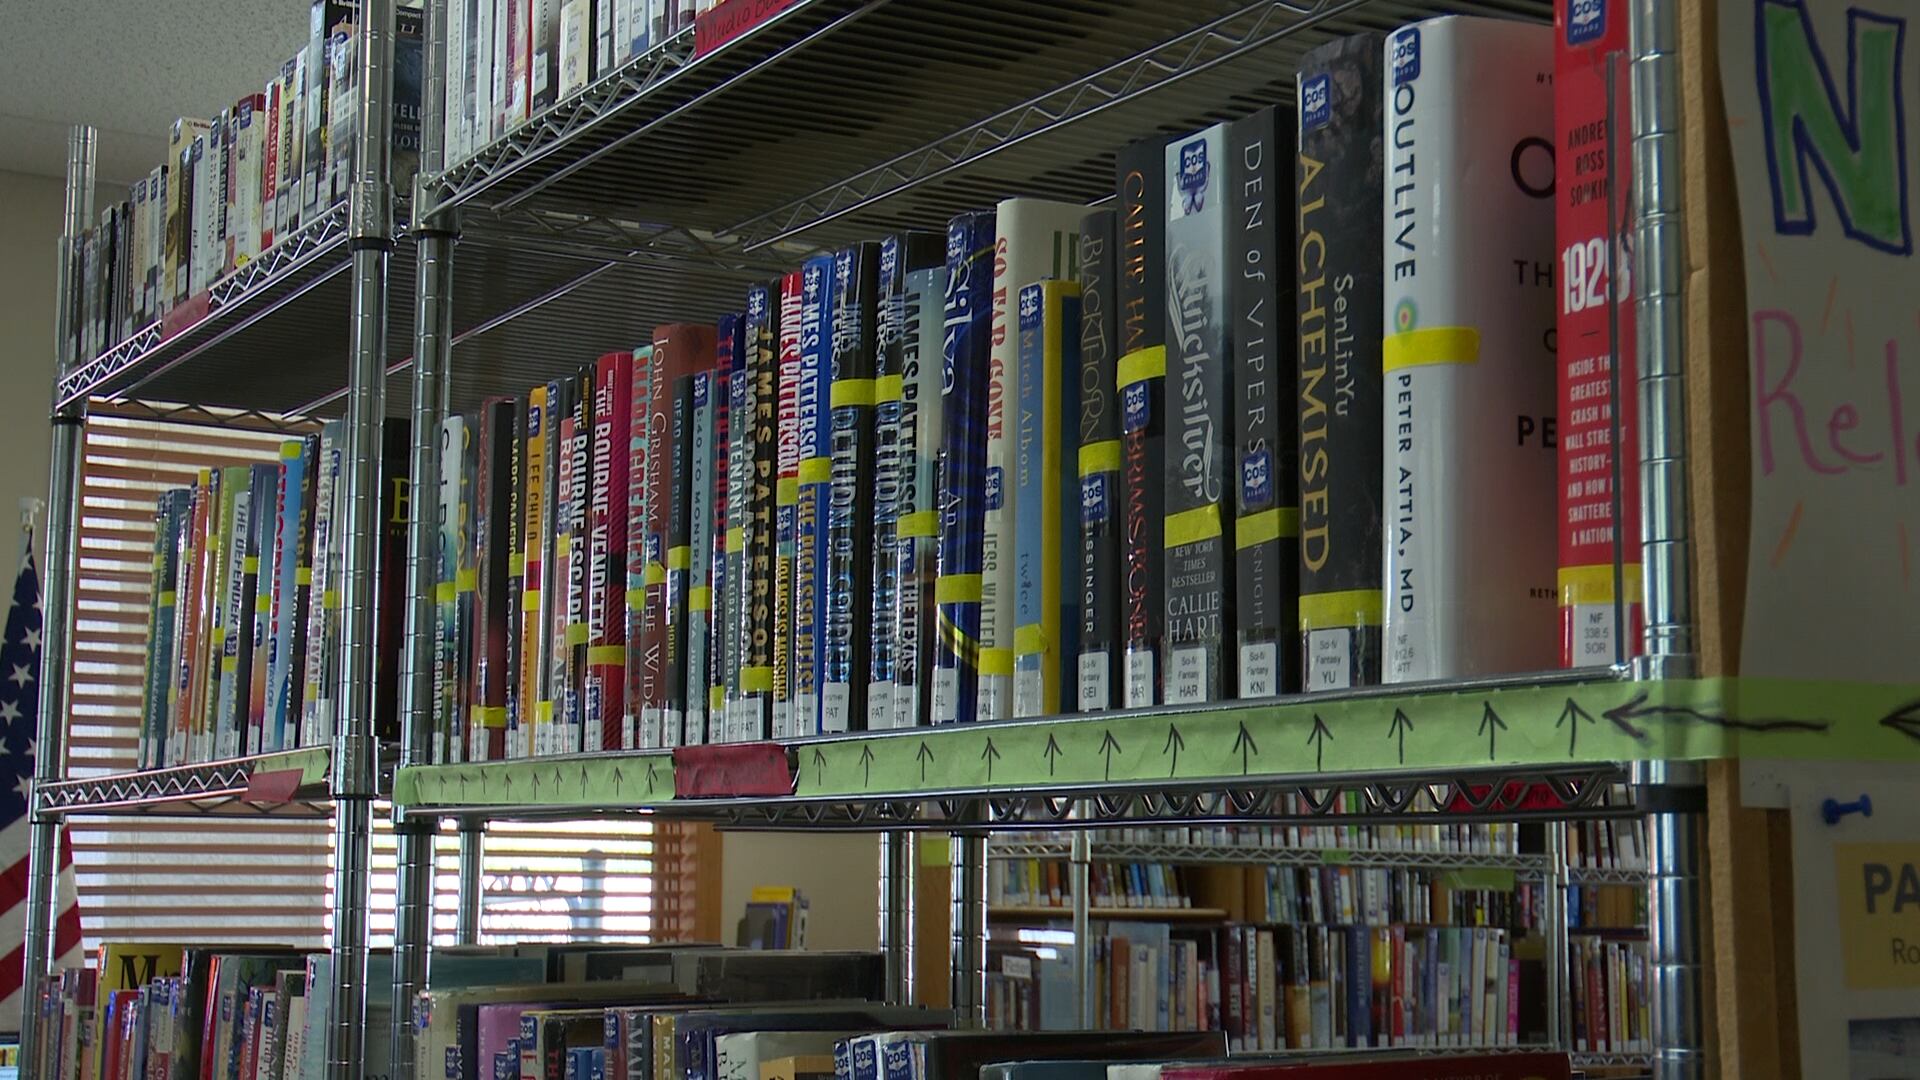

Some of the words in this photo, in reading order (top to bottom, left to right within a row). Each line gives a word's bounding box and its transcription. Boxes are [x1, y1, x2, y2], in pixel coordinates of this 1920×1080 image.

[1183, 151, 1205, 169] COS
[1575, 150, 1605, 176] ROSS
[1244, 140, 1263, 231] DEN
[1393, 83, 1416, 282] OUTLIVE
[992, 236, 1008, 279] SO
[1244, 249, 1266, 281] of
[902, 286, 920, 383] JAMES
[1126, 296, 1145, 353] HA
[1333, 272, 1355, 417] SenLinYu
[652, 337, 669, 401] JOHN
[1021, 331, 1037, 399] Mitch
[1245, 298, 1266, 455] VIPERS
[1299, 152, 1330, 574] ALCHEMISED
[1567, 358, 1595, 379] INSIDE
[595, 386, 607, 417] THE
[756, 326, 774, 445] JAMES
[799, 351, 819, 459] PATTERSO
[1753, 308, 1920, 486] Rel
[573, 400, 584, 431] THE
[1397, 374, 1412, 454] PETER
[1570, 406, 1598, 426] CRASH
[897, 382, 918, 514] PATTERSO
[1020, 409, 1034, 488] Albom
[1565, 434, 1584, 451] WALL
[648, 411, 667, 522] GRISHAM
[729, 435, 745, 521] TENANT
[1244, 465, 1266, 481] COS
[1567, 479, 1583, 499] AND
[1585, 478, 1606, 494] HOW
[800, 486, 816, 528] THE
[947, 491, 962, 527] An
[1397, 466, 1413, 558] ATTIA,
[1568, 501, 1612, 523] SHATTERE
[691, 489, 701, 585] MONTREA
[1571, 530, 1577, 547] A
[1579, 527, 1614, 545] NATION
[228, 535, 245, 630] DEFENDER
[1171, 571, 1216, 589] BESTSELLER
[1399, 568, 1414, 614] MD
[644, 584, 662, 633] THE
[1167, 591, 1220, 618] CALLIE
[1167, 614, 1219, 643] HART
[553, 615, 566, 701] CRAIS
[1320, 670, 1337, 685] YU
[1178, 685, 1199, 699] HAR
[1249, 678, 1266, 695] KNI
[854, 1050, 873, 1064] COS
[887, 1051, 907, 1065] COS
